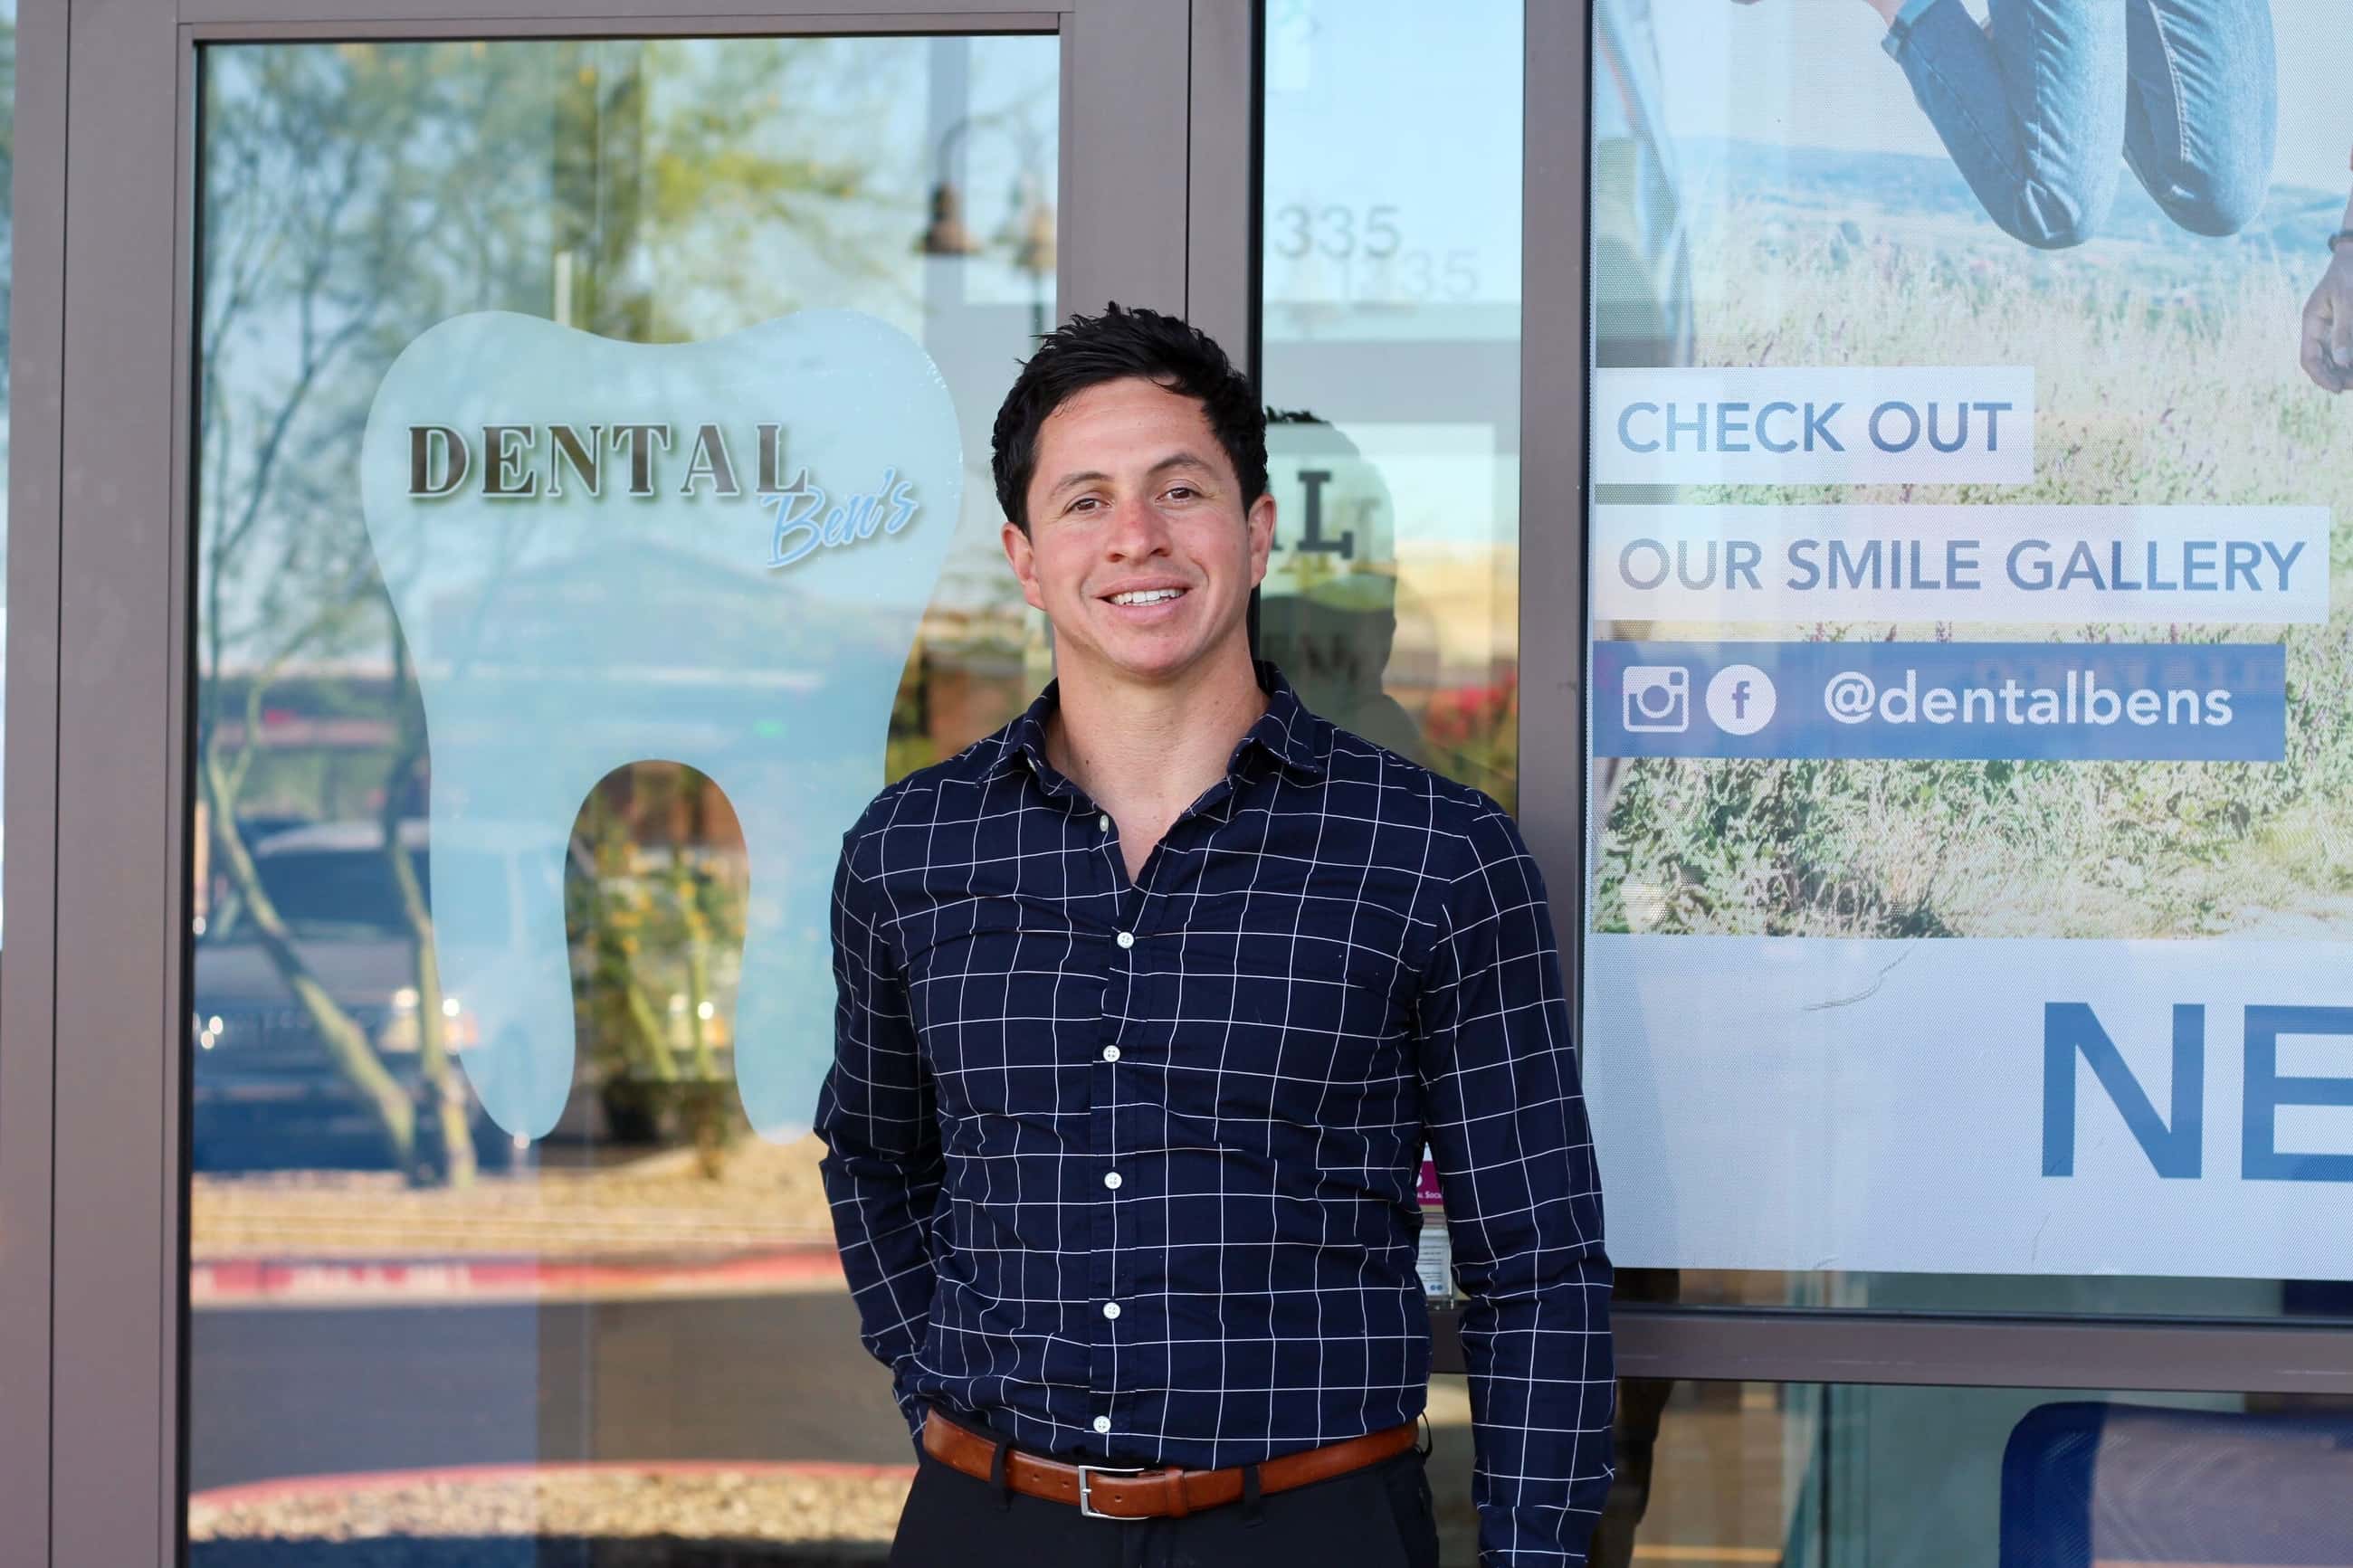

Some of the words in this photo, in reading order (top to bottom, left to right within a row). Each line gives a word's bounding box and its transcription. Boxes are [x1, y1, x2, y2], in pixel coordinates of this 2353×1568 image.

[407, 423, 808, 497] DENTAL
[1617, 400, 1845, 454] CHECK
[1869, 400, 2012, 453] OUT
[760, 465, 919, 568] Ben's
[1618, 537, 1763, 591] OUR
[1786, 537, 1981, 592] SMILE
[2005, 538, 2306, 593] GALLERY
[1824, 669, 2234, 727] @dentalbens
[2042, 1002, 2353, 1183] NE
